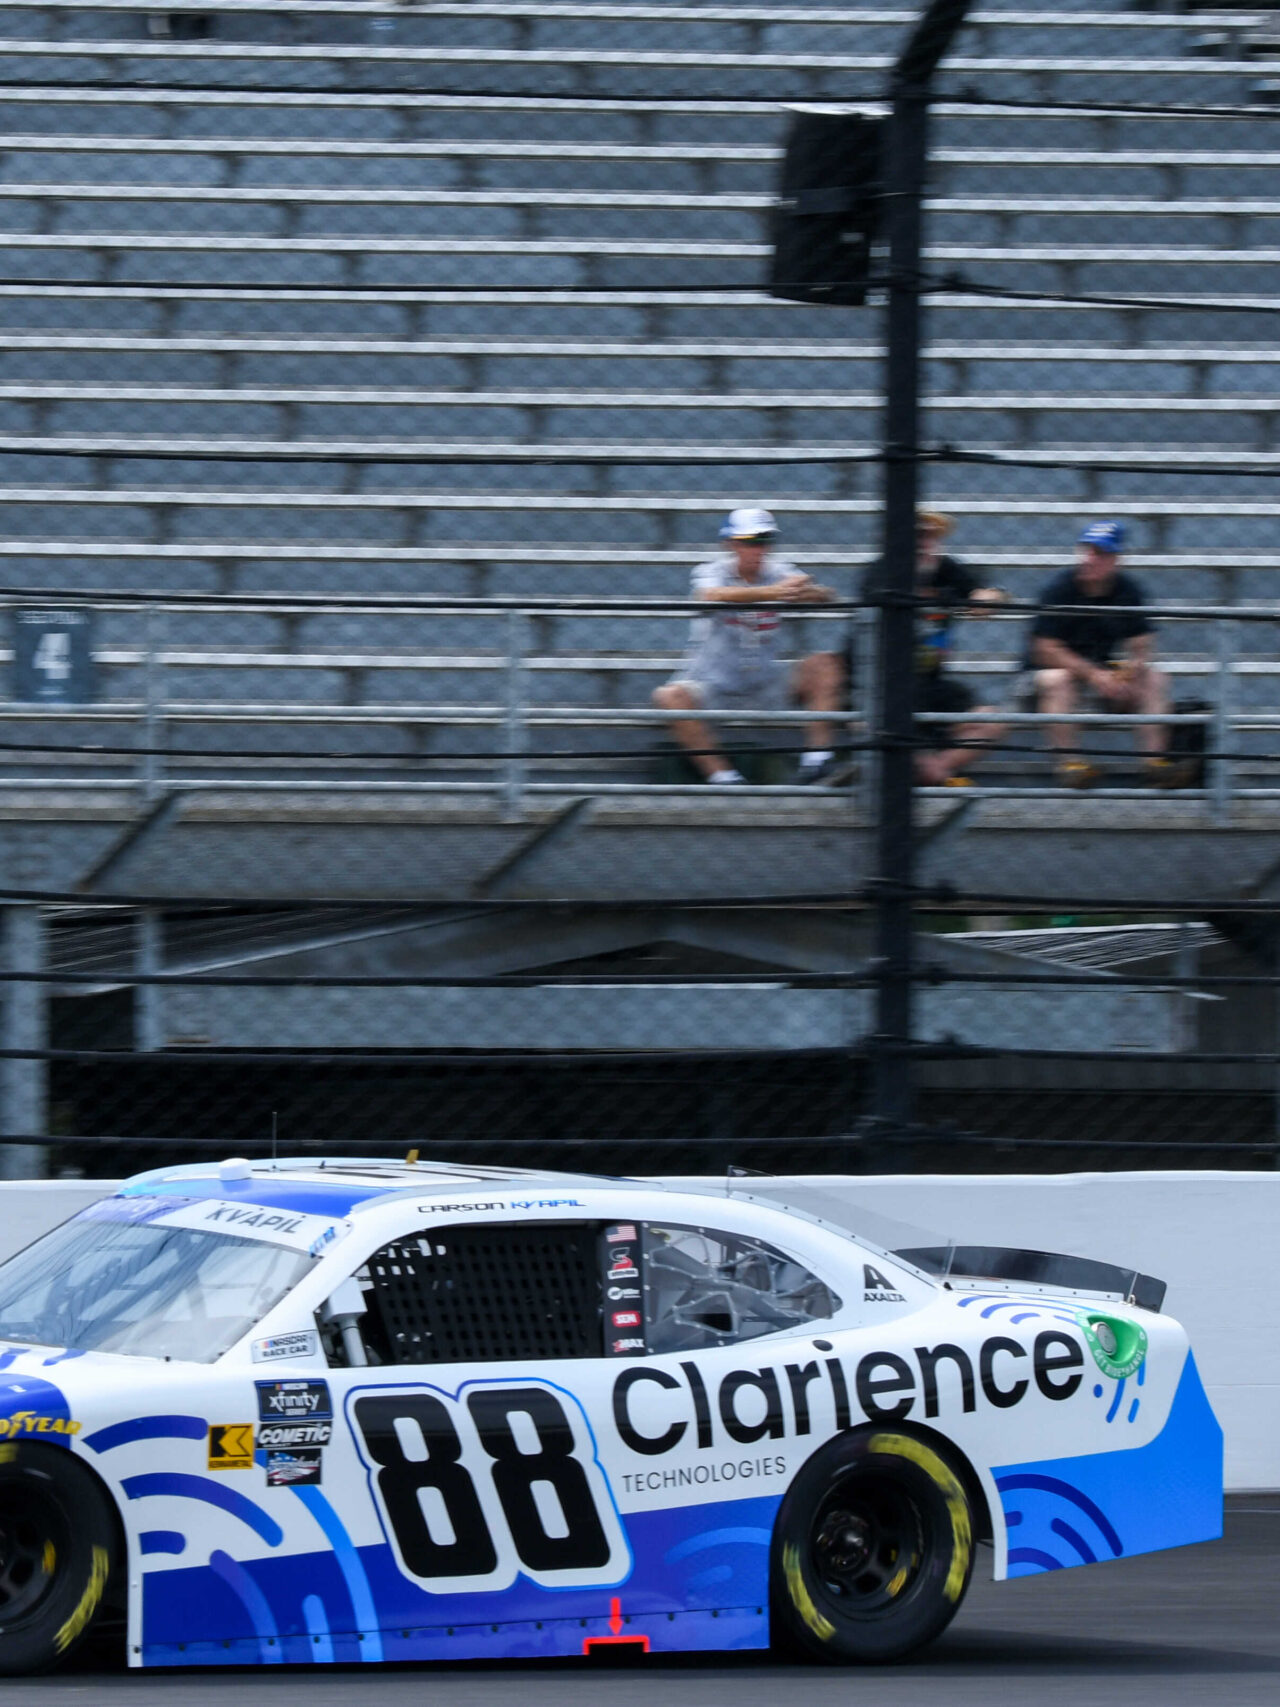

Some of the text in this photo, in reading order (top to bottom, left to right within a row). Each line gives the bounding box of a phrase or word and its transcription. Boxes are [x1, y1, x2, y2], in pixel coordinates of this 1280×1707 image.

[417, 1199, 587, 1213] CARSON KVAPIL
[205, 1206, 303, 1235] KVAPIL
[864, 1292, 908, 1303] AXALTA
[272, 1334, 308, 1347] NASCAR
[262, 1345, 309, 1358] RACE CAR
[269, 1391, 320, 1411] xfinity
[612, 1330, 1085, 1455] Clarience
[259, 1425, 331, 1444] COMETIC
[353, 1387, 612, 1578] 88
[622, 1456, 787, 1493] TECHNOLOGIES
